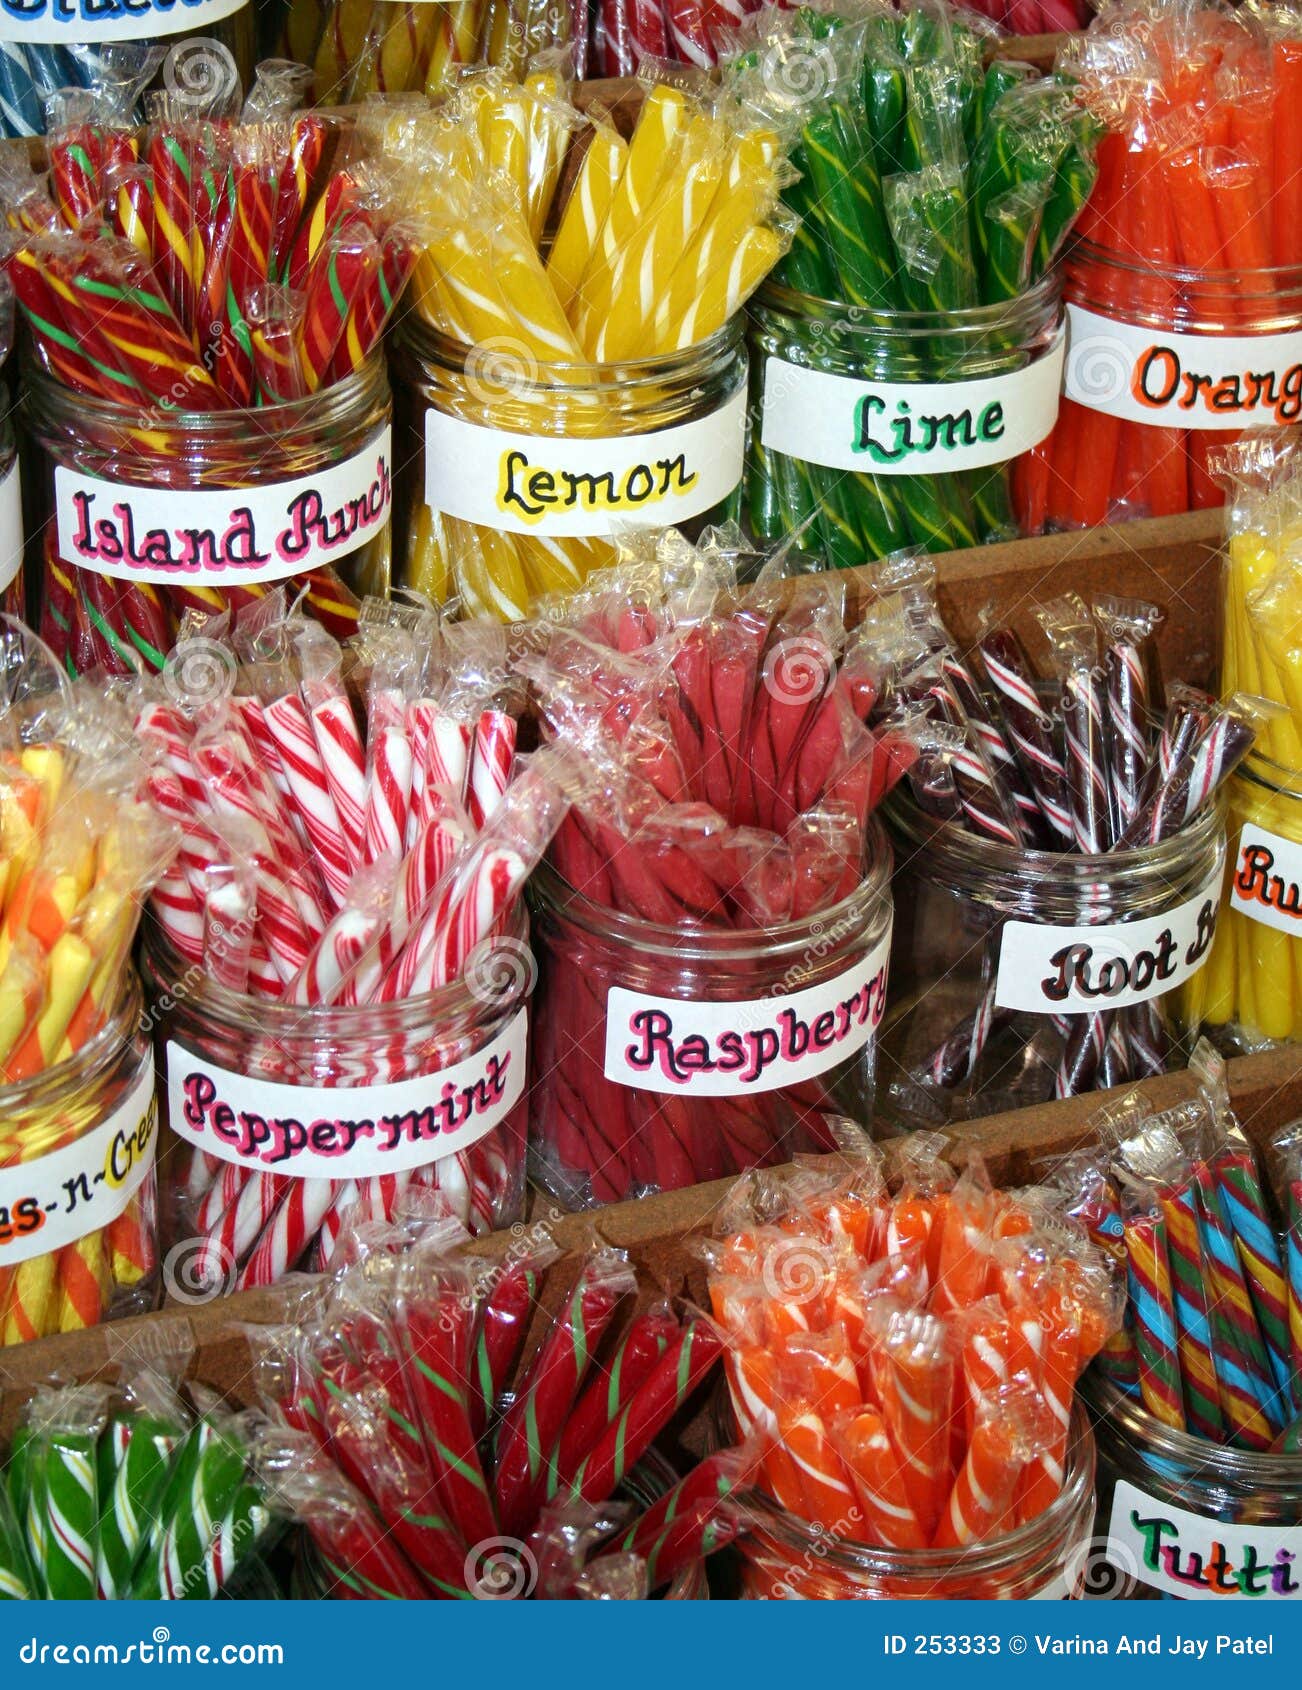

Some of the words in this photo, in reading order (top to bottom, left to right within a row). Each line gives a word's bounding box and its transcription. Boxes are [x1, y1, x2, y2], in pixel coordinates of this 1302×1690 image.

[1130, 344, 1302, 426] Orang
[850, 394, 1005, 464] Lime
[72, 490, 268, 572] Island
[275, 456, 392, 563] Punch
[496, 448, 700, 525] Lemon
[1041, 928, 1178, 1001] Root
[624, 957, 887, 1084] Raspberry
[183, 1050, 512, 1164] Peppermint
[1130, 1509, 1300, 1598] Tutti
